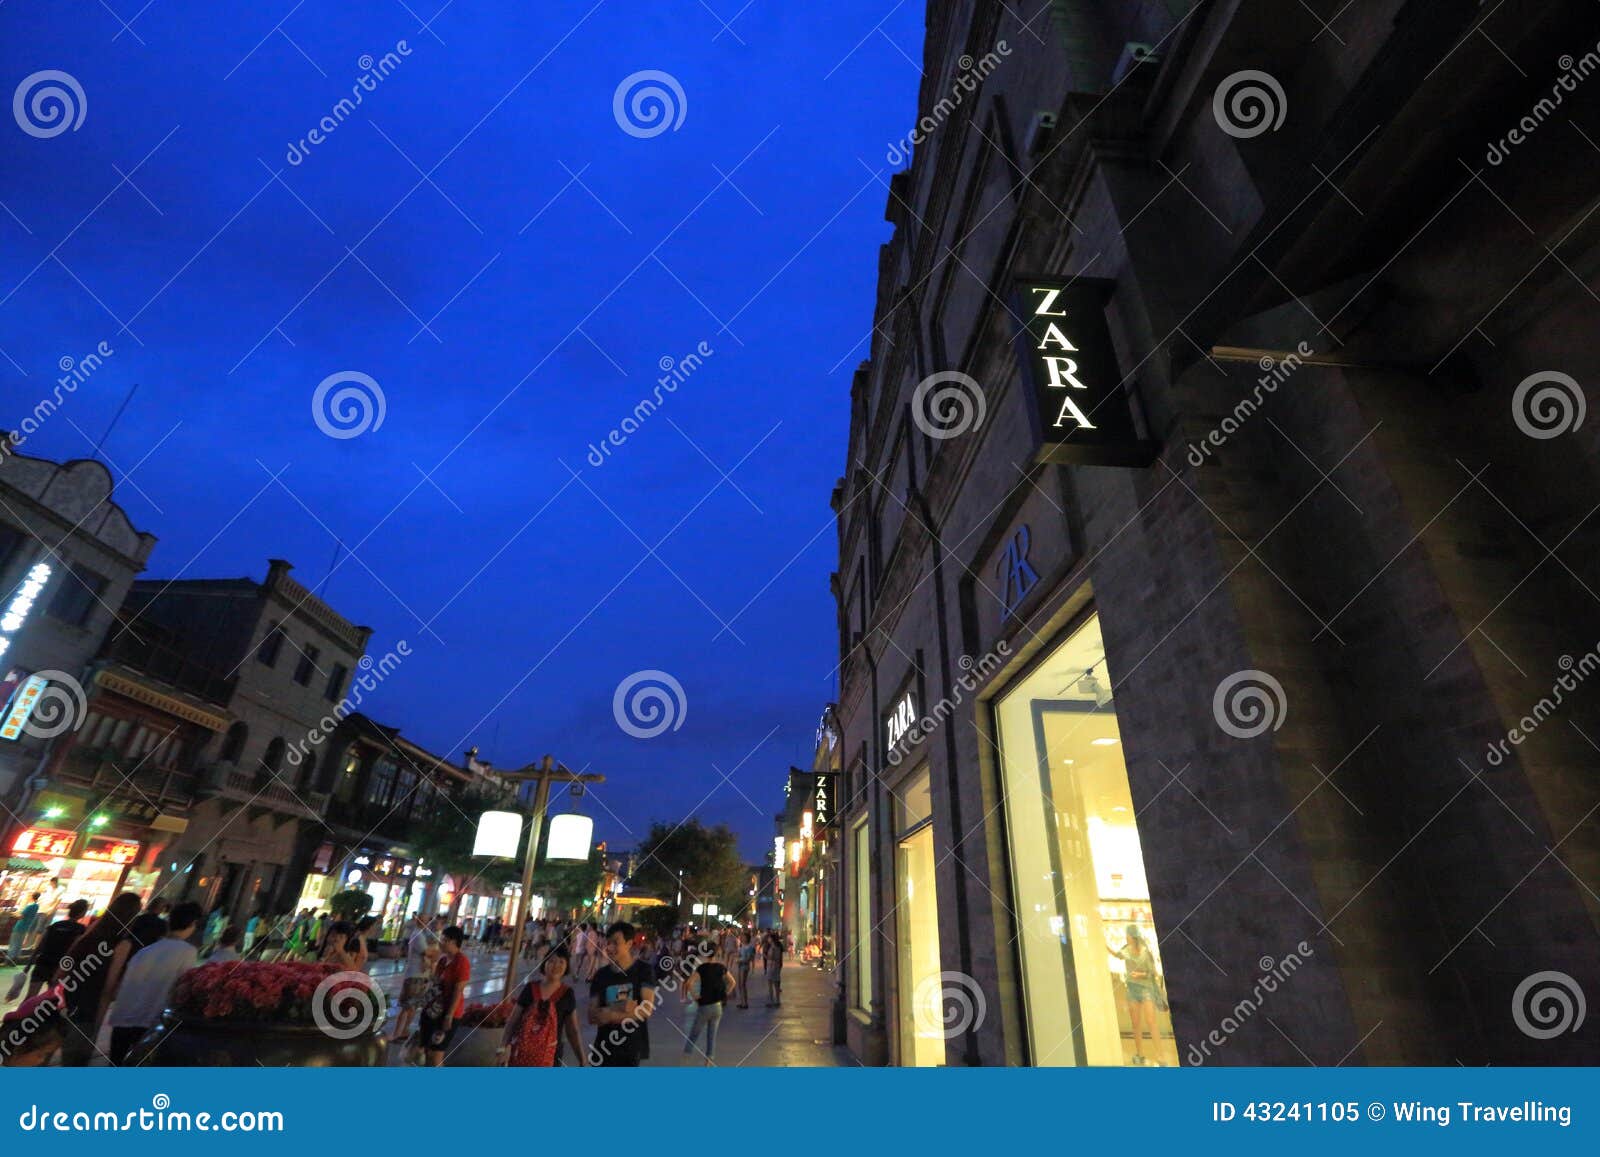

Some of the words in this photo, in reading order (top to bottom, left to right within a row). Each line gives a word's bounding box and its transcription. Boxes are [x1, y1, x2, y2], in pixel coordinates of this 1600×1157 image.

[1032, 288, 1097, 429] ZARA
[886, 693, 916, 751] ZARA
[815, 776, 828, 824] ZARA
